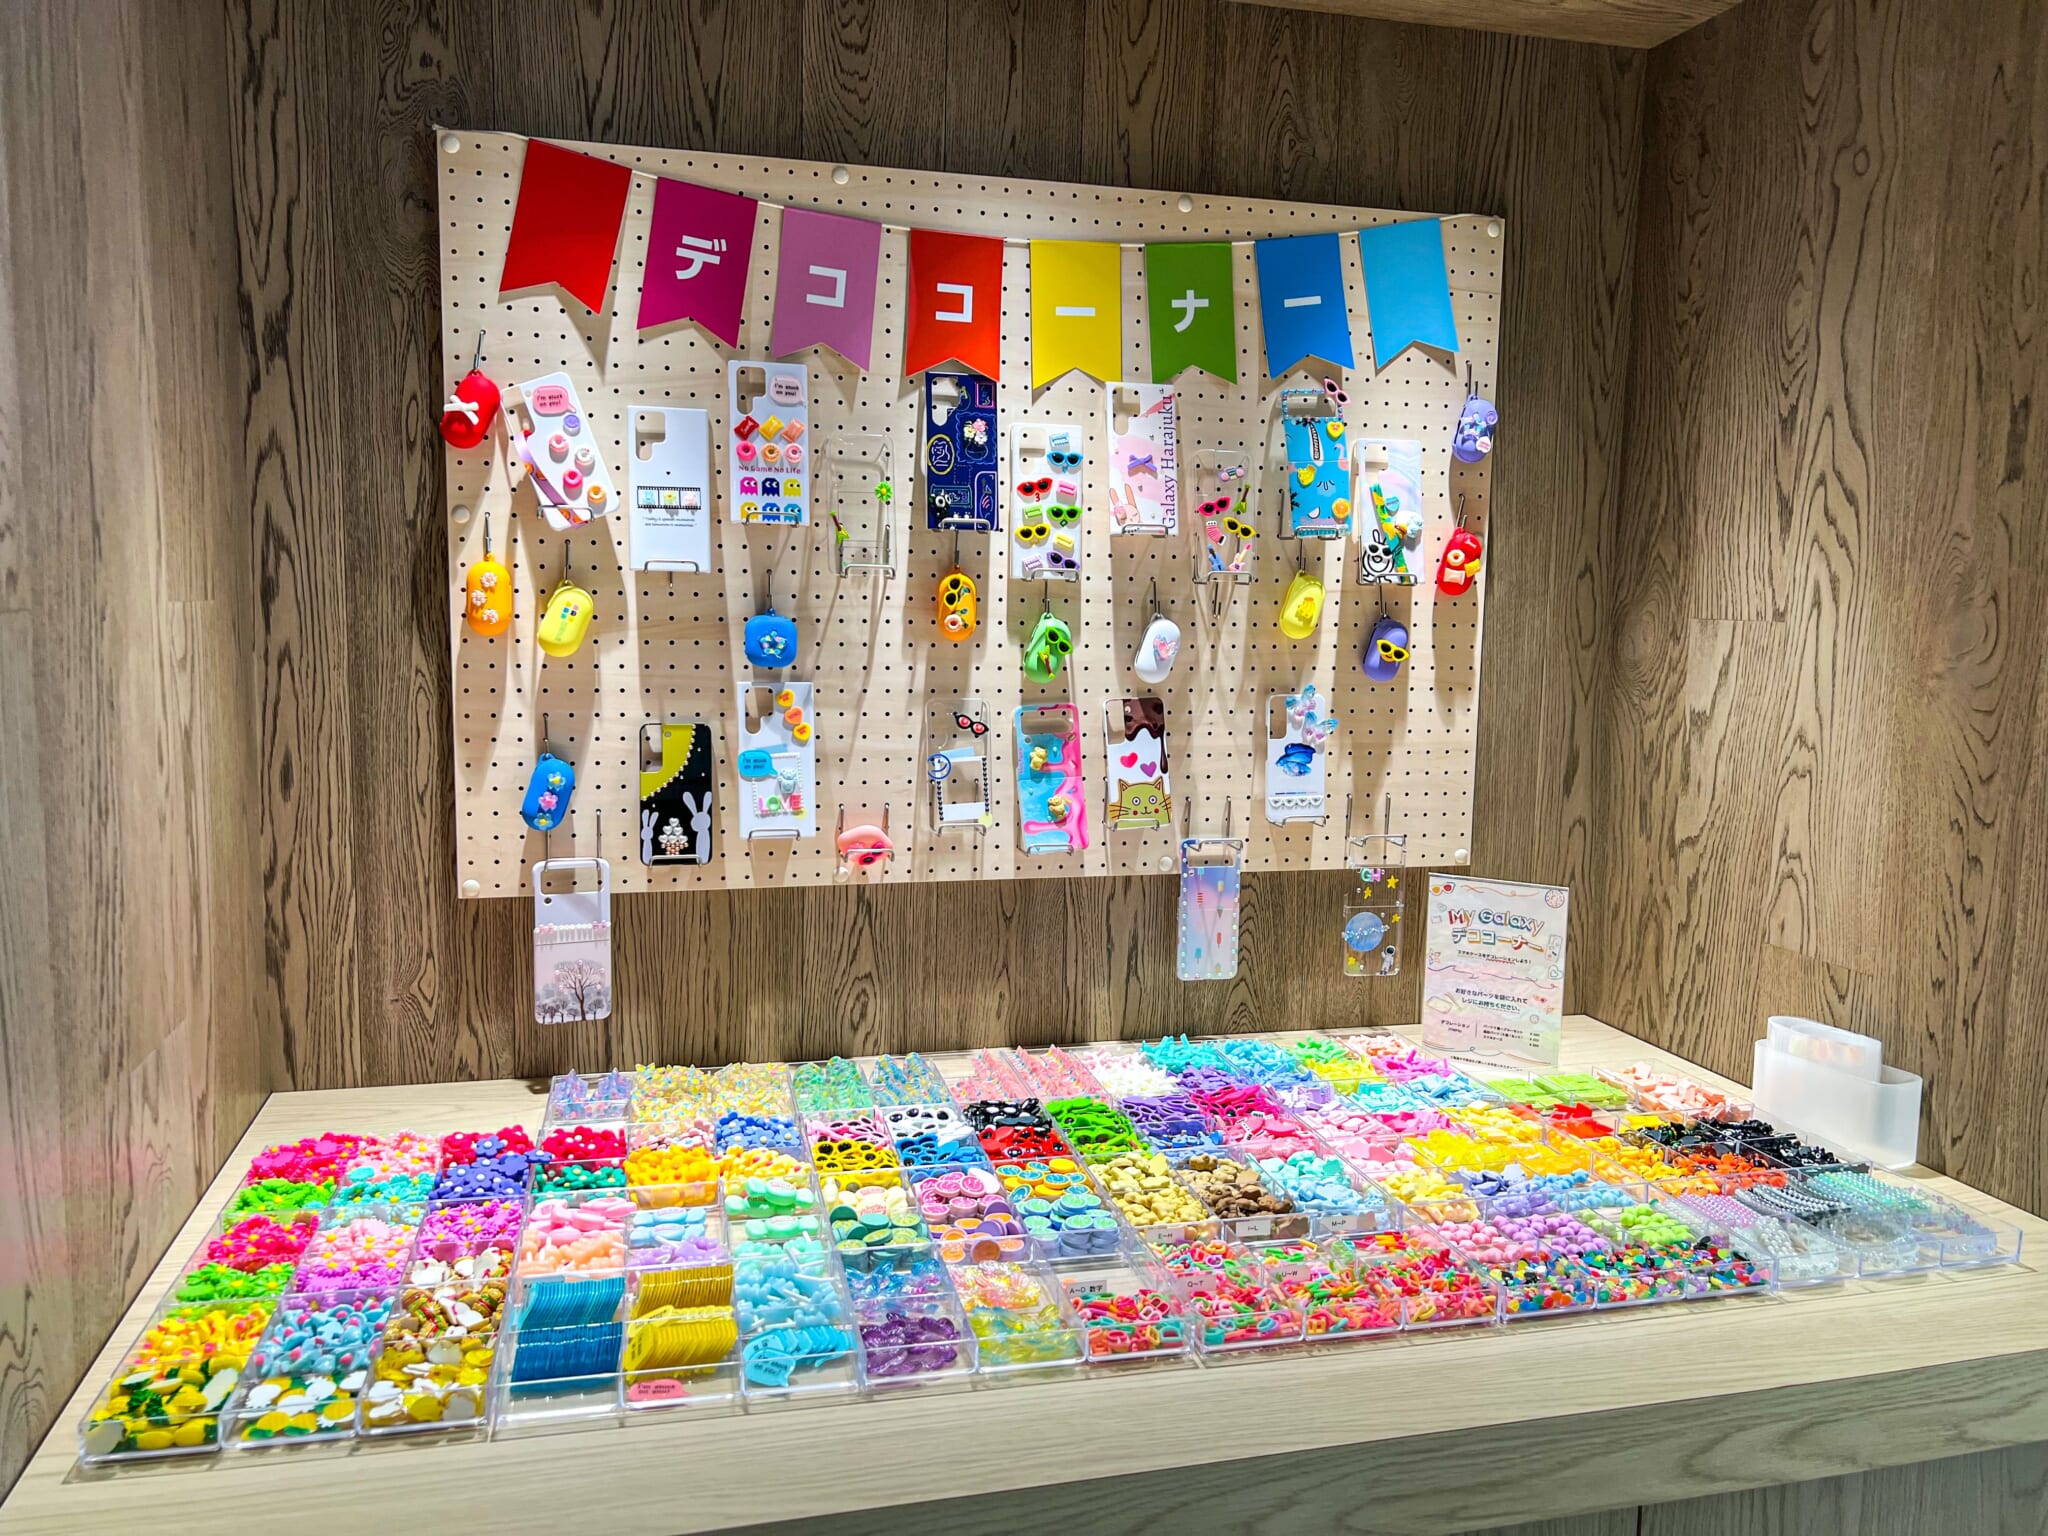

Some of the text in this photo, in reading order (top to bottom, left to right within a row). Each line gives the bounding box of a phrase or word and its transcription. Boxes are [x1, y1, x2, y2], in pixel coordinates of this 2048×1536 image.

[786, 466, 801, 474] Life
[1159, 395, 1178, 529] Galaxy Harajuku
[758, 793, 802, 814] LOVE
[1361, 868, 1382, 883] GH
[1448, 908, 1545, 938] My Galaxy
[1452, 927, 1545, 953] デココーナー
